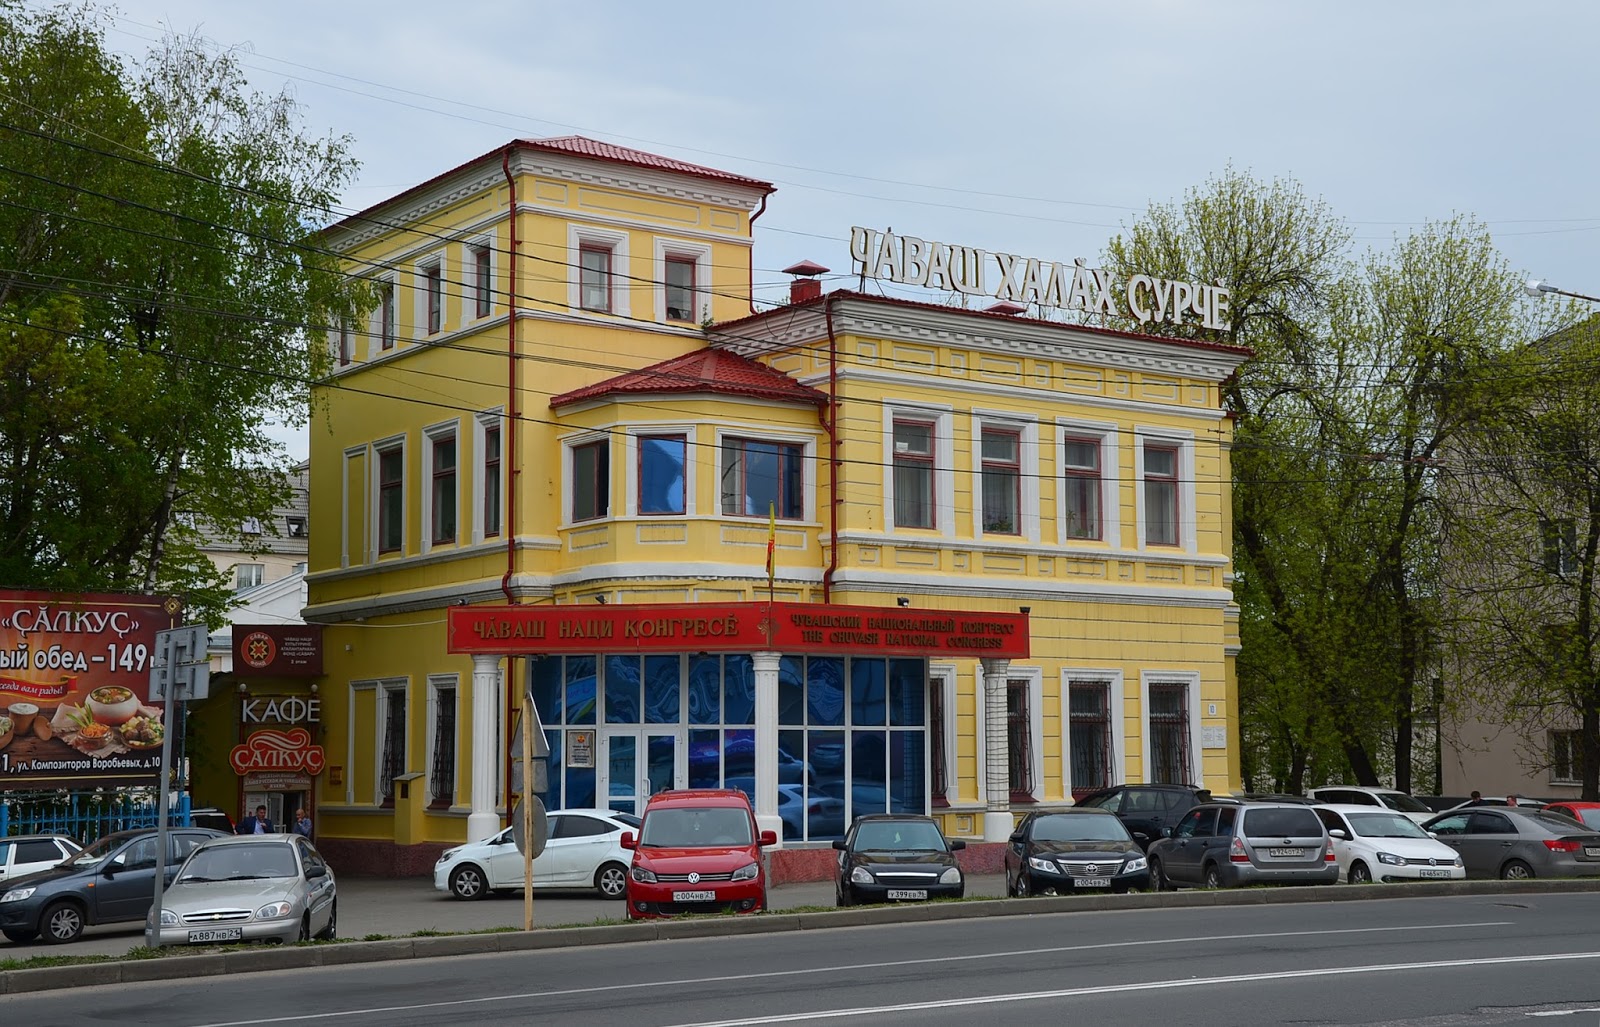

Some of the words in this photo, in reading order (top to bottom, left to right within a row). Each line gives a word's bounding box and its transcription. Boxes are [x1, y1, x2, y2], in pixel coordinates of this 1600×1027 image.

[558, 618, 614, 639] НАЦИ
[868, 616, 956, 634] НАЦИОНАЛЬНЫЙ
[961, 621, 1014, 635] КОНГРЕСС
[802, 630, 823, 642] THE
[830, 631, 879, 644] CHUVASH
[886, 633, 939, 647] NATIONAL
[947, 636, 1003, 649] CONGRESS
[34, 644, 88, 671] обед
[21, 686, 38, 694] вам
[38, 686, 63, 697] рады!
[242, 696, 320, 724] КАФЕ
[17, 762, 29, 773] ул.
[31, 759, 91, 771] Композиторов
